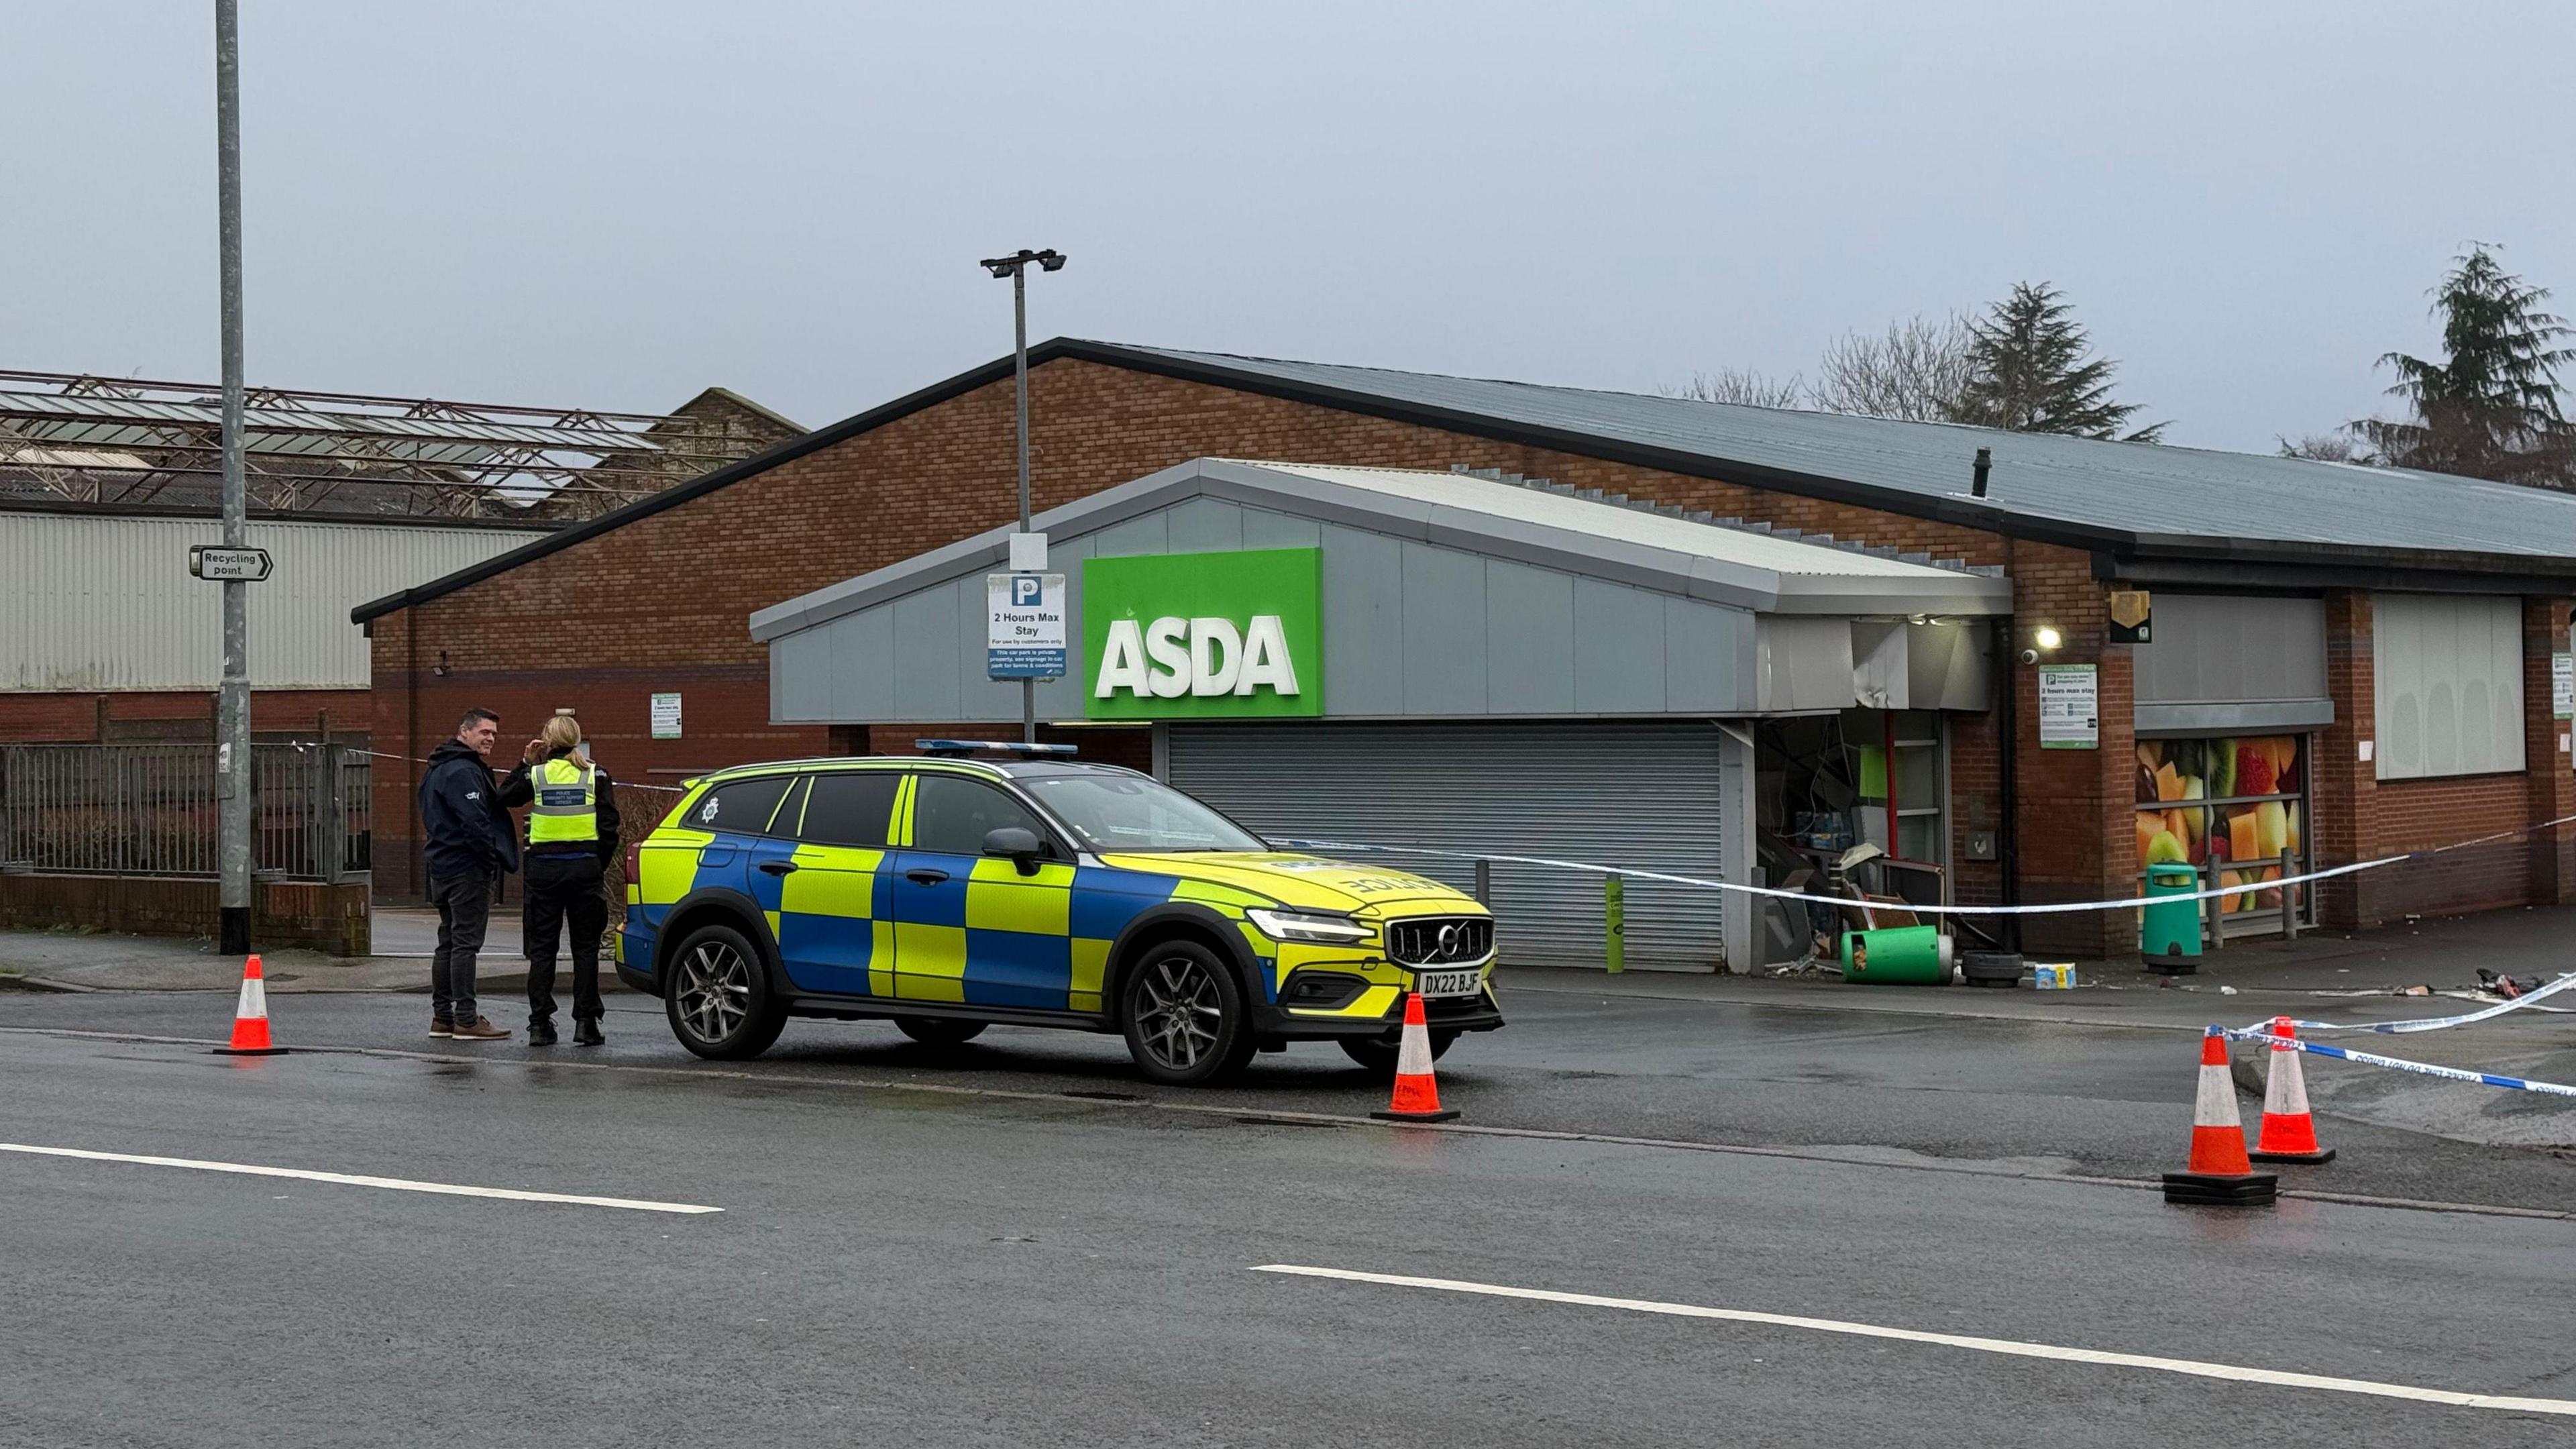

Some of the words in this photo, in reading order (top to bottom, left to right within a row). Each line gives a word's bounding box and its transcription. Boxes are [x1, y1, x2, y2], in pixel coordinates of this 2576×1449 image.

[205, 553, 256, 564] Recycling
[214, 566, 242, 576] point
[994, 613, 1000, 622] 2
[1004, 613, 1035, 622] Hours
[1038, 613, 1059, 622] Max
[1015, 626, 1038, 637] Stay
[1095, 615, 1300, 698] ASDA
[1424, 975, 1456, 994] DX22
[1458, 973, 1479, 992] BJF
